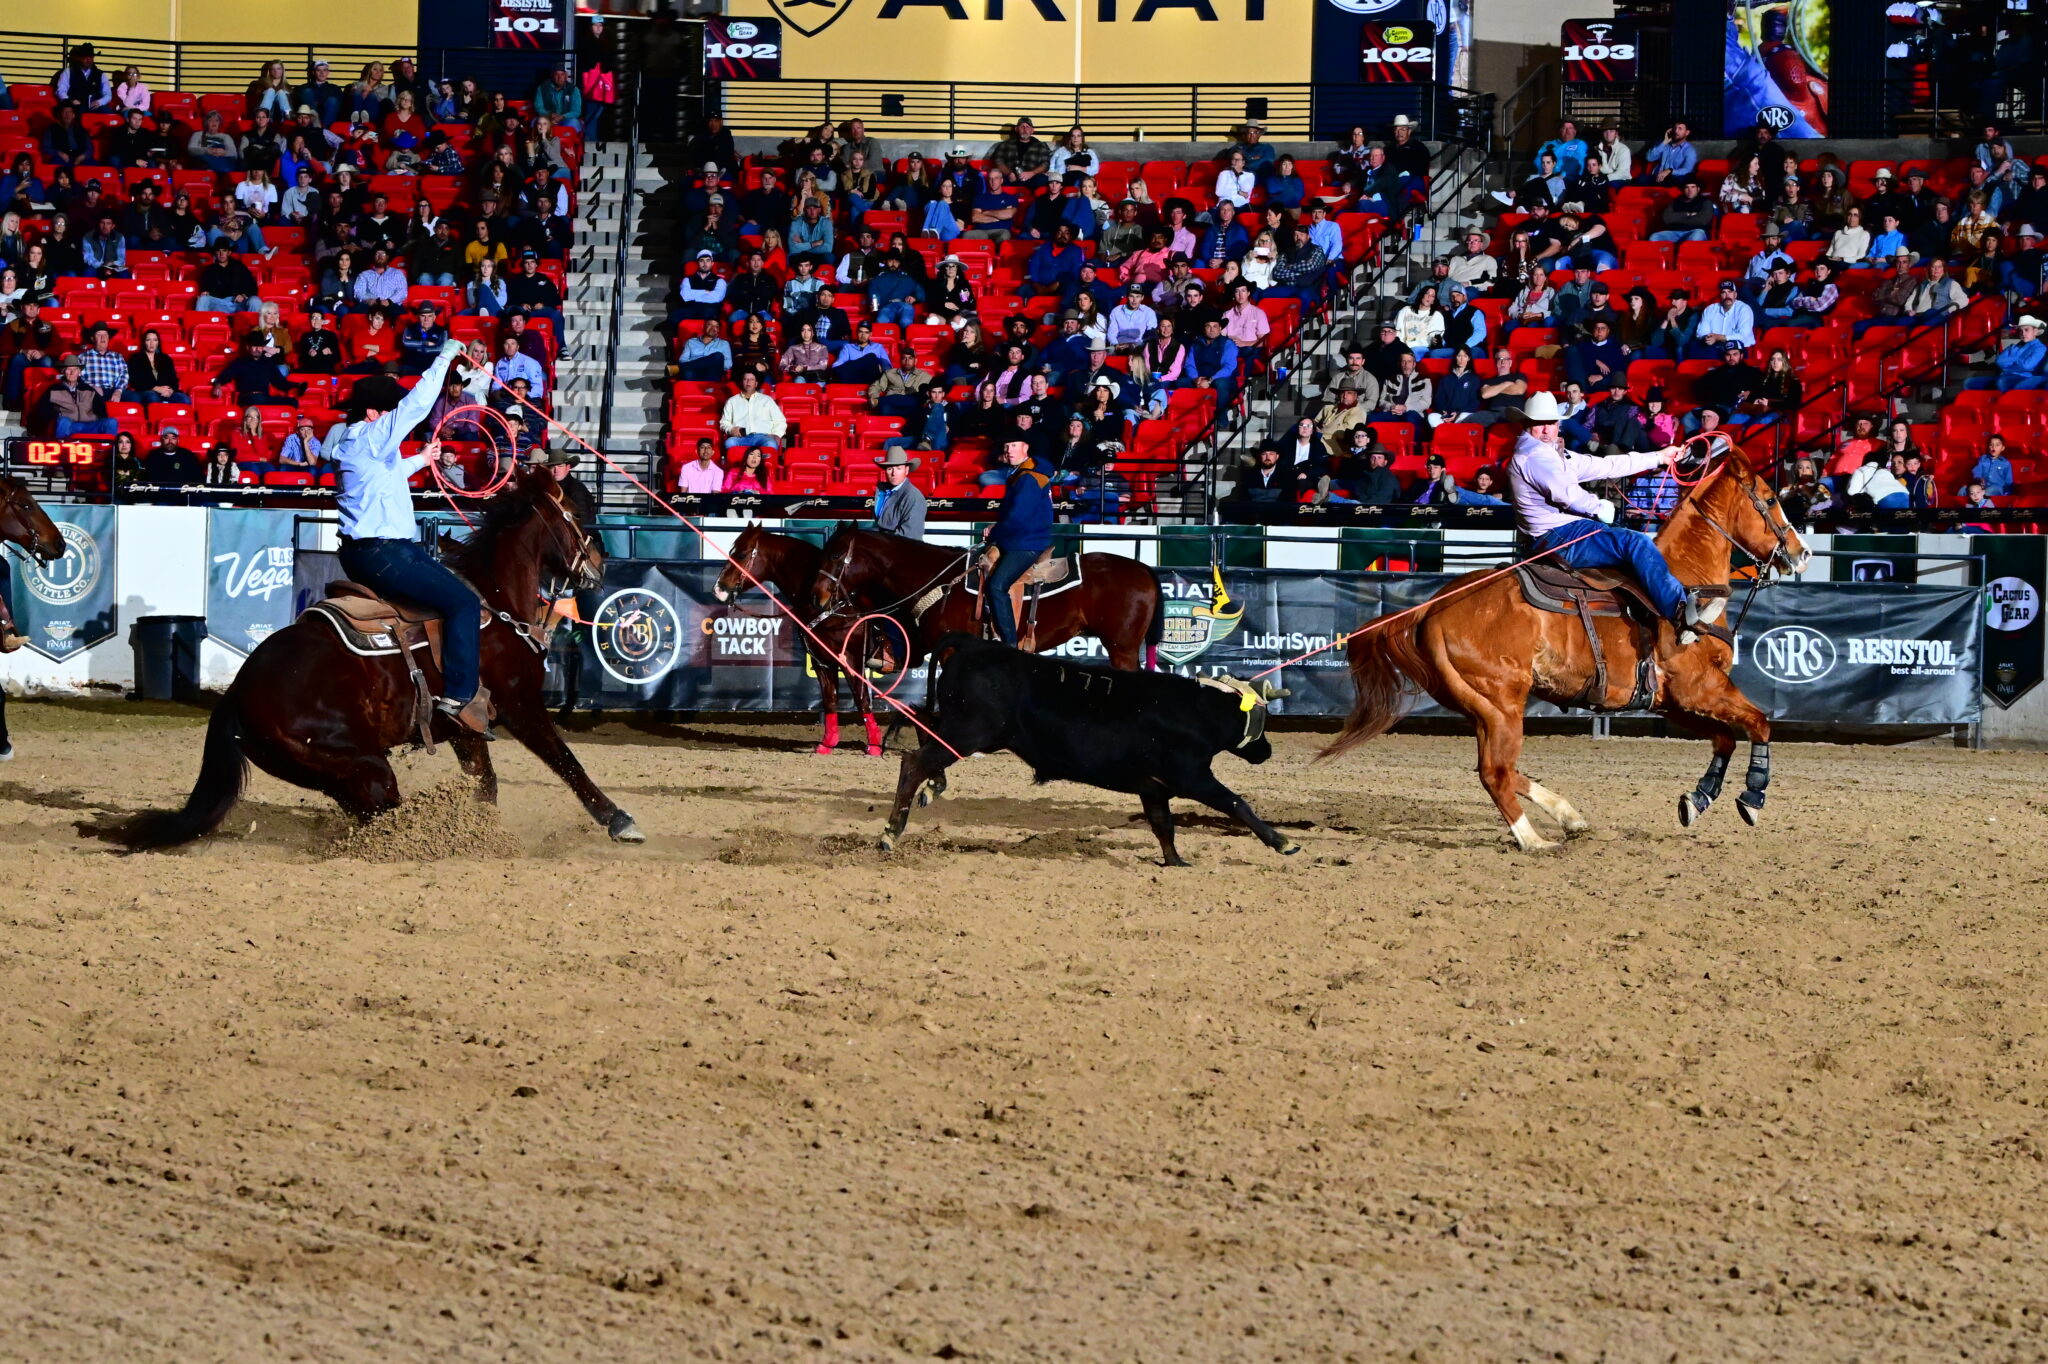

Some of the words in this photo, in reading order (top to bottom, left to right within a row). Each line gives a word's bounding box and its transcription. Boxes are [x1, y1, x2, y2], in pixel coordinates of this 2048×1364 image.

[494, 17, 558, 32] 101
[707, 43, 777, 58] 102
[1363, 47, 1431, 62] 102
[1564, 44, 1634, 60] 103
[1762, 107, 1789, 128] NRS
[271, 551, 293, 564] LAS
[214, 550, 293, 602] Vega
[31, 577, 71, 599] CATTLE
[72, 578, 90, 593] CO.
[1160, 583, 1214, 598] RIAT
[605, 595, 665, 618] RIATA
[701, 617, 782, 635] COWBOY
[717, 637, 766, 655] TACK
[1243, 631, 1327, 654] LubriSyn
[1766, 631, 1822, 677] NRS
[1848, 638, 1956, 666] RESISTOL
[1304, 658, 1323, 667] Joint
[1891, 666, 1909, 675] best
[1911, 666, 1956, 676] all-around
